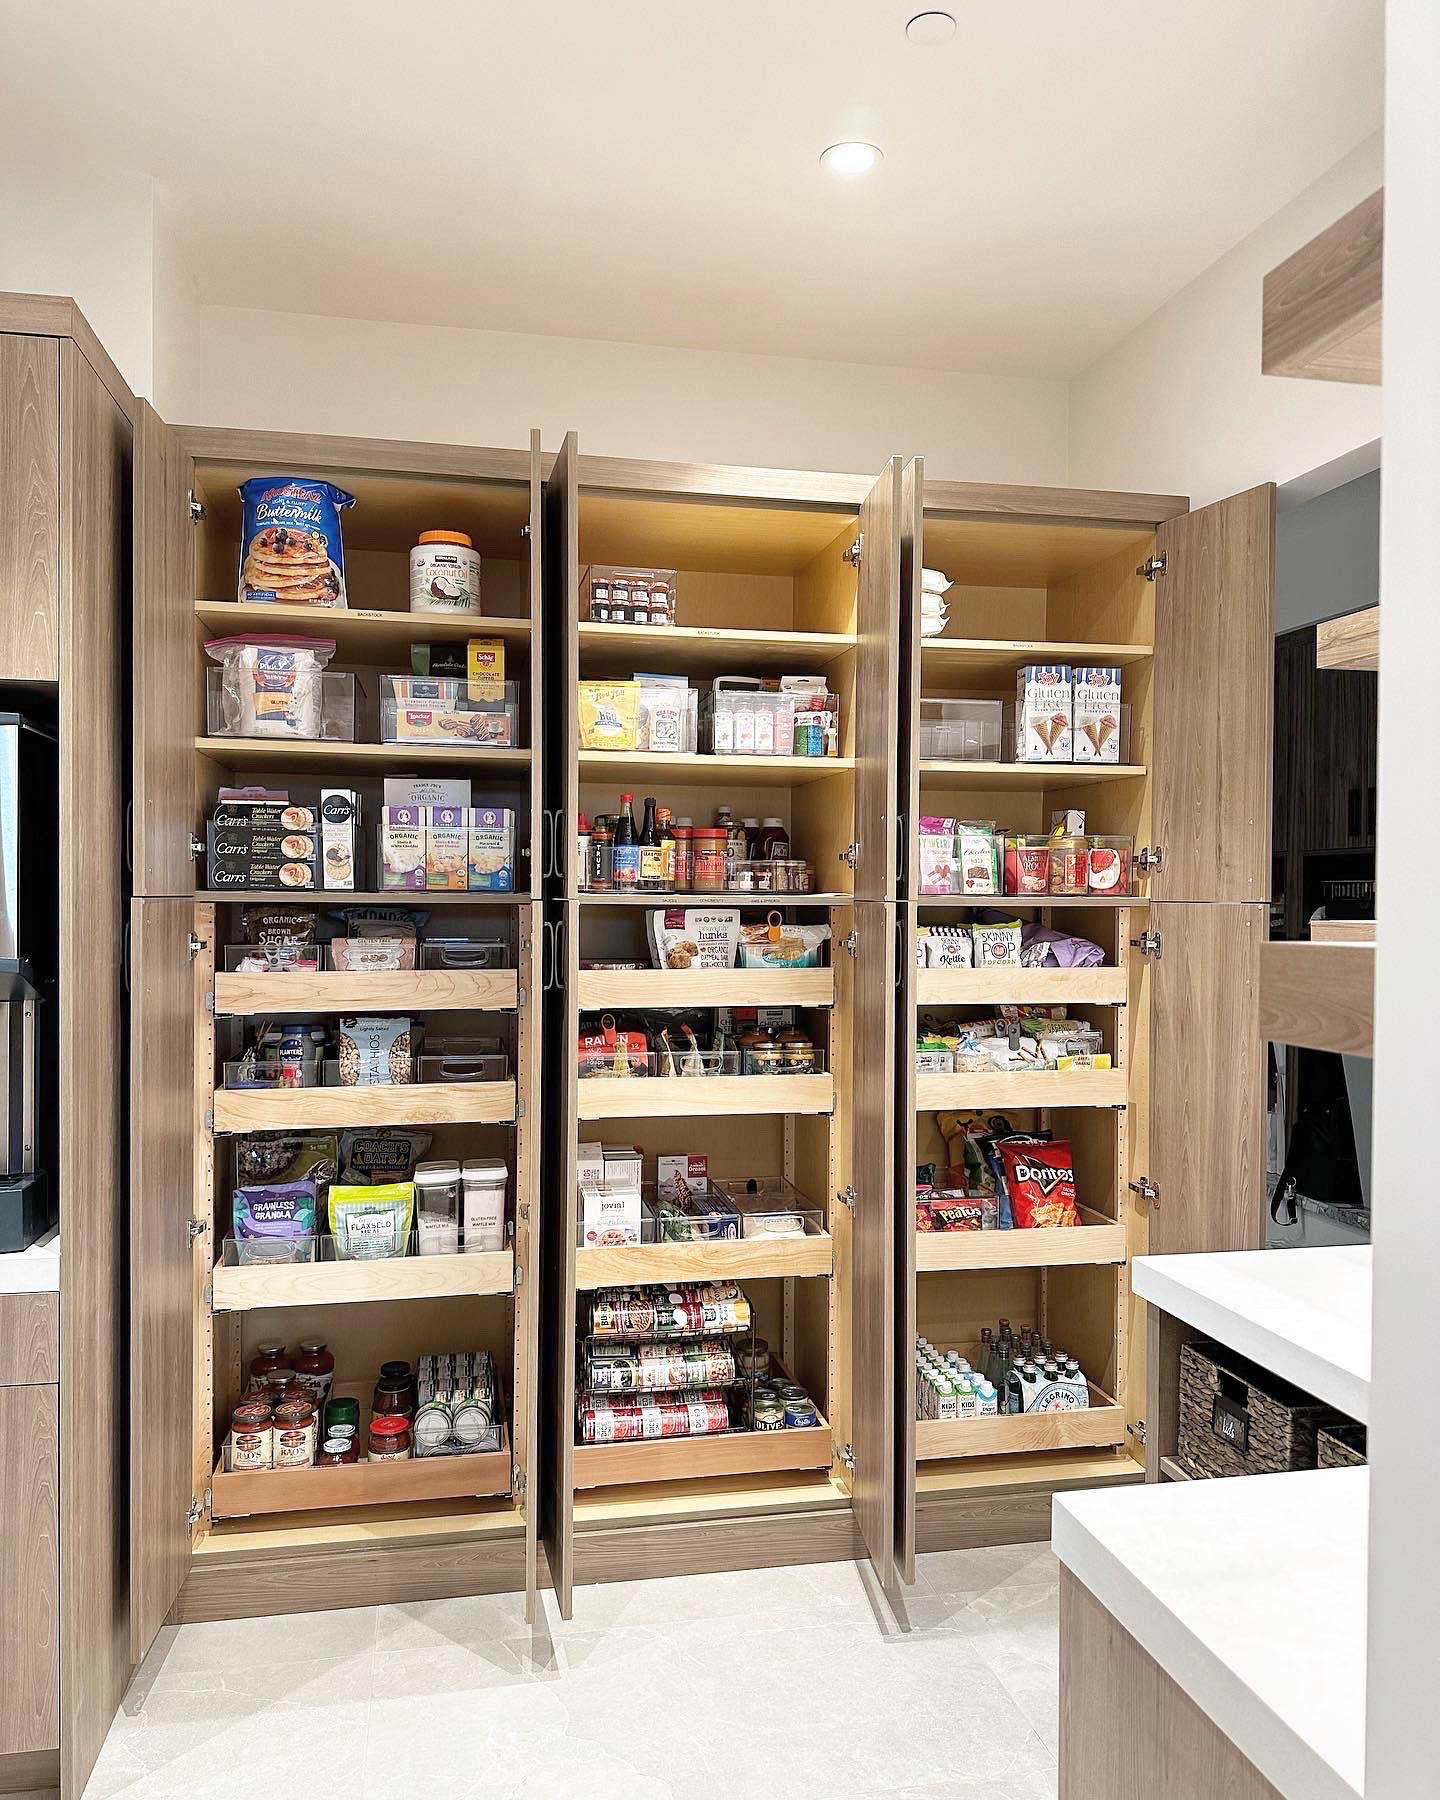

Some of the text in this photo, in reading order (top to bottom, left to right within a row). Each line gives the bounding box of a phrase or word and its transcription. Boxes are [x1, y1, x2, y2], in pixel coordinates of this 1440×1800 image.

[256, 503, 322, 524] Buttermilk
[425, 568, 468, 579] Coconut Oil
[1027, 687, 1071, 699] Gluten
[1077, 689, 1120, 701] Gluten
[1034, 699, 1064, 708] Free
[1083, 700, 1113, 710] Free
[411, 794, 446, 802] ORGANIC
[324, 804, 351, 815] Carr's
[217, 814, 249, 827] Carr's
[389, 832, 419, 840] ORGANIC
[432, 832, 462, 840] ORGANIC
[475, 834, 504, 842] ORGANIC
[217, 842, 249, 855] Carr's
[215, 870, 247, 883] Carr's
[263, 915, 297, 925] ORGANIC
[258, 931, 299, 946] SUGAR
[697, 930, 729, 940] hunks
[981, 931, 1014, 942] SKINNY
[982, 942, 1016, 960] POP
[939, 954, 966, 966] Kettle
[279, 1047, 303, 1056] PLANTERS
[354, 1139, 410, 1153] COACH'S
[364, 1152, 397, 1164] OATS
[1015, 1165, 1074, 1183] Doritos
[252, 1201, 295, 1212] GRAINLESS
[601, 1201, 626, 1211] jovial
[254, 1210, 292, 1221] GRANOLA
[350, 1220, 392, 1231] FLAXSEED
[756, 1420, 785, 1431] OLIVES
[1222, 1417, 1236, 1439] kids
[236, 1451, 262, 1460] RAO'S
[280, 1447, 306, 1457] RAO'S
